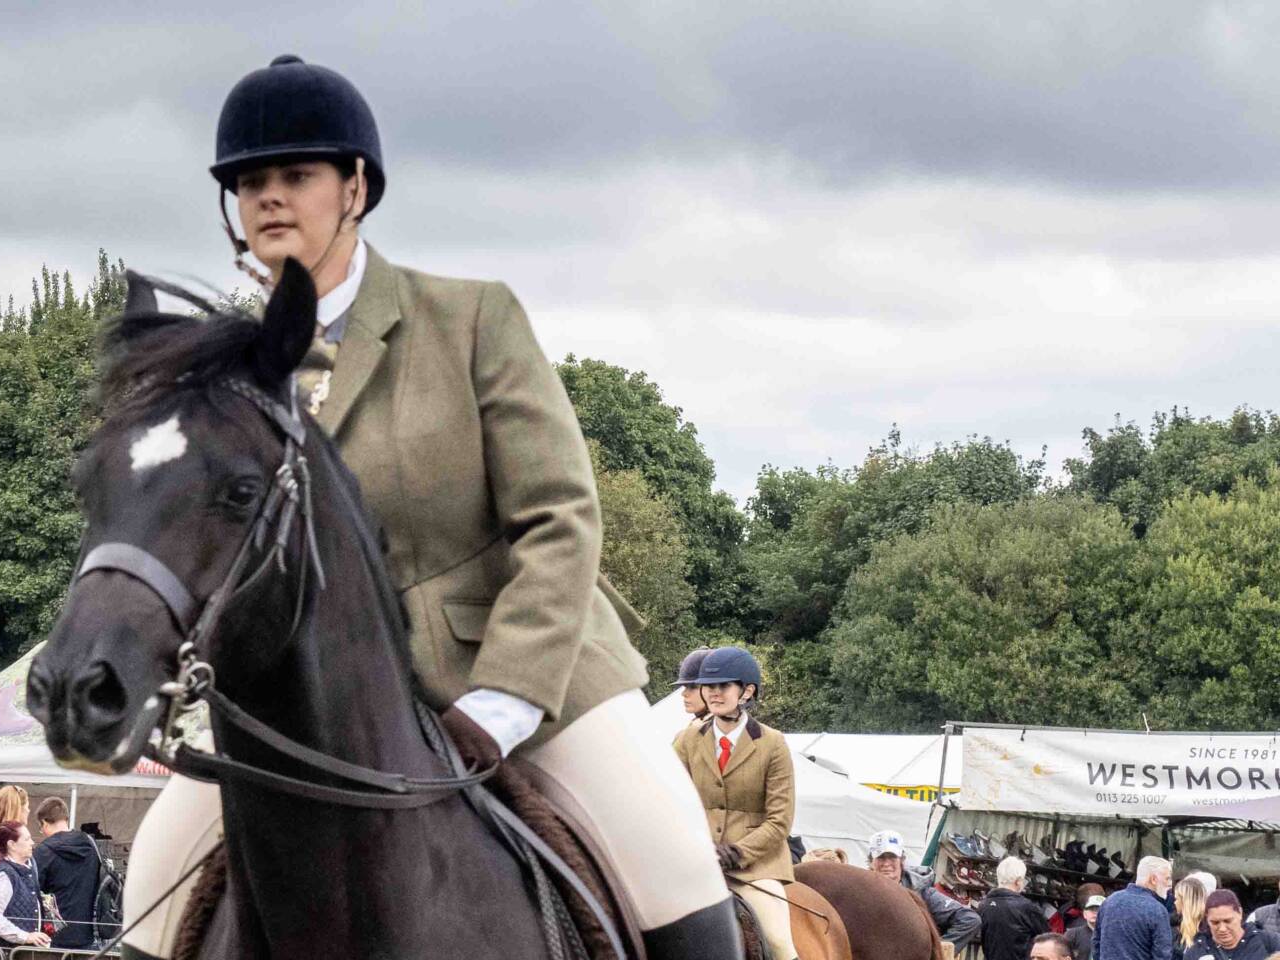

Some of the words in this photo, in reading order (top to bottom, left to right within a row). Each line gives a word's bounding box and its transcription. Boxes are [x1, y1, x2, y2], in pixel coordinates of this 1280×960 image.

[1189, 747, 1237, 760] SINCE
[1244, 749, 1277, 760] 1981
[1121, 794, 1139, 804] 225
